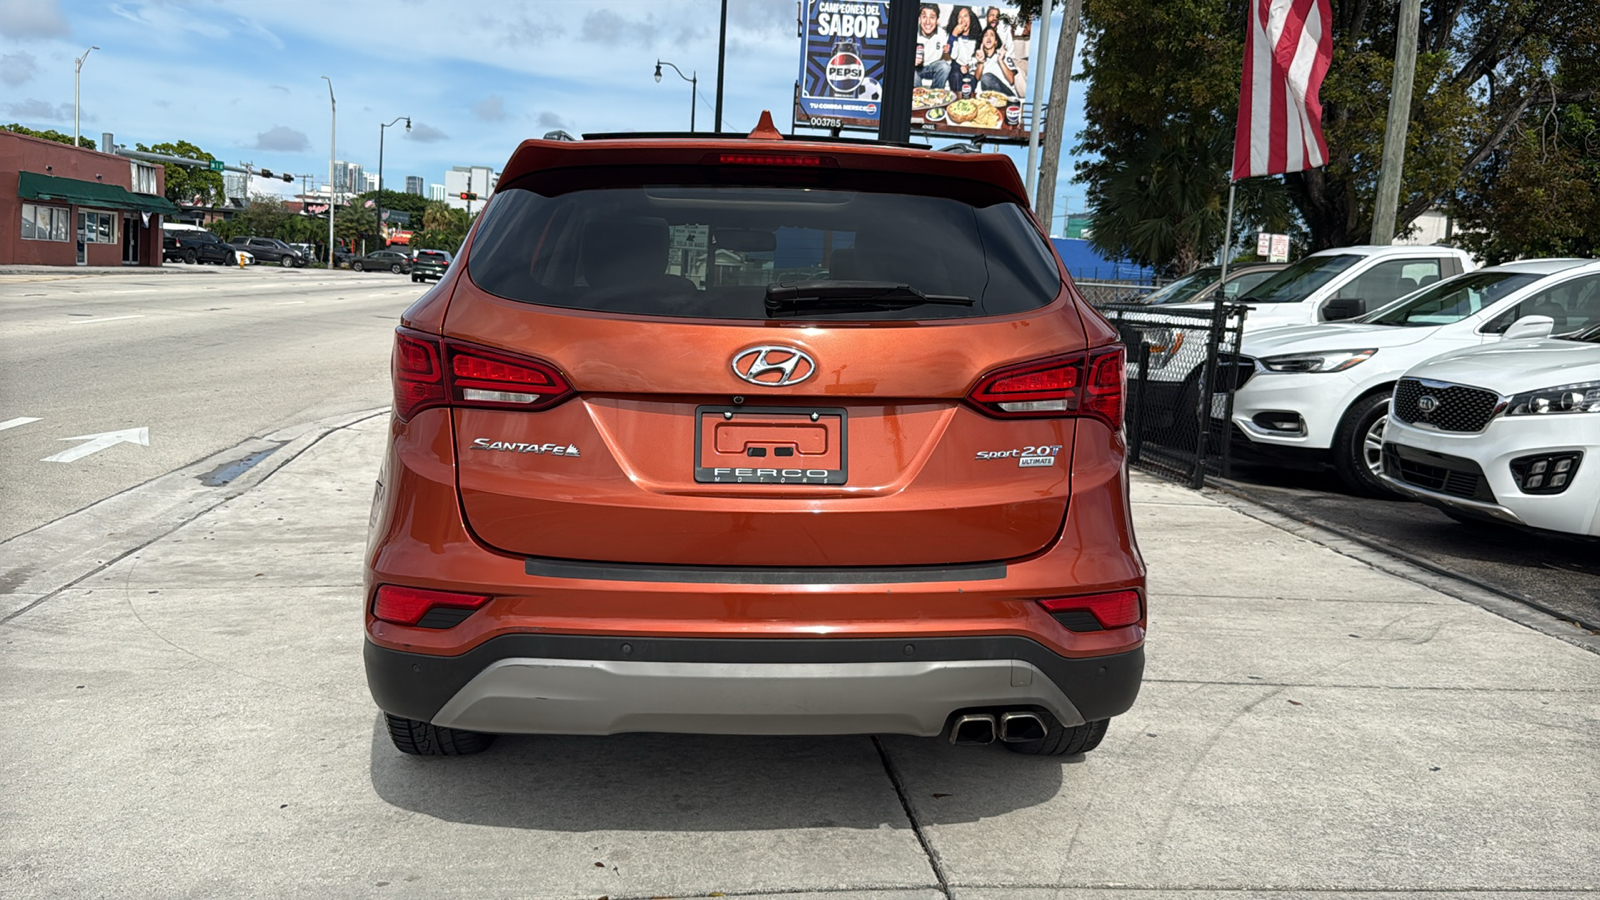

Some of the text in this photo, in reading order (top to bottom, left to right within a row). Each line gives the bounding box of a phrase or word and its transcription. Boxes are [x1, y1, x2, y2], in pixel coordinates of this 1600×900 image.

[819, 2, 880, 15] CAMPEONES DEL
[818, 13, 880, 38] SABOR
[829, 67, 862, 77] PEPSI
[810, 117, 841, 127] 003785
[1021, 445, 1062, 456] 2.0T
[714, 468, 828, 477] FERCO
